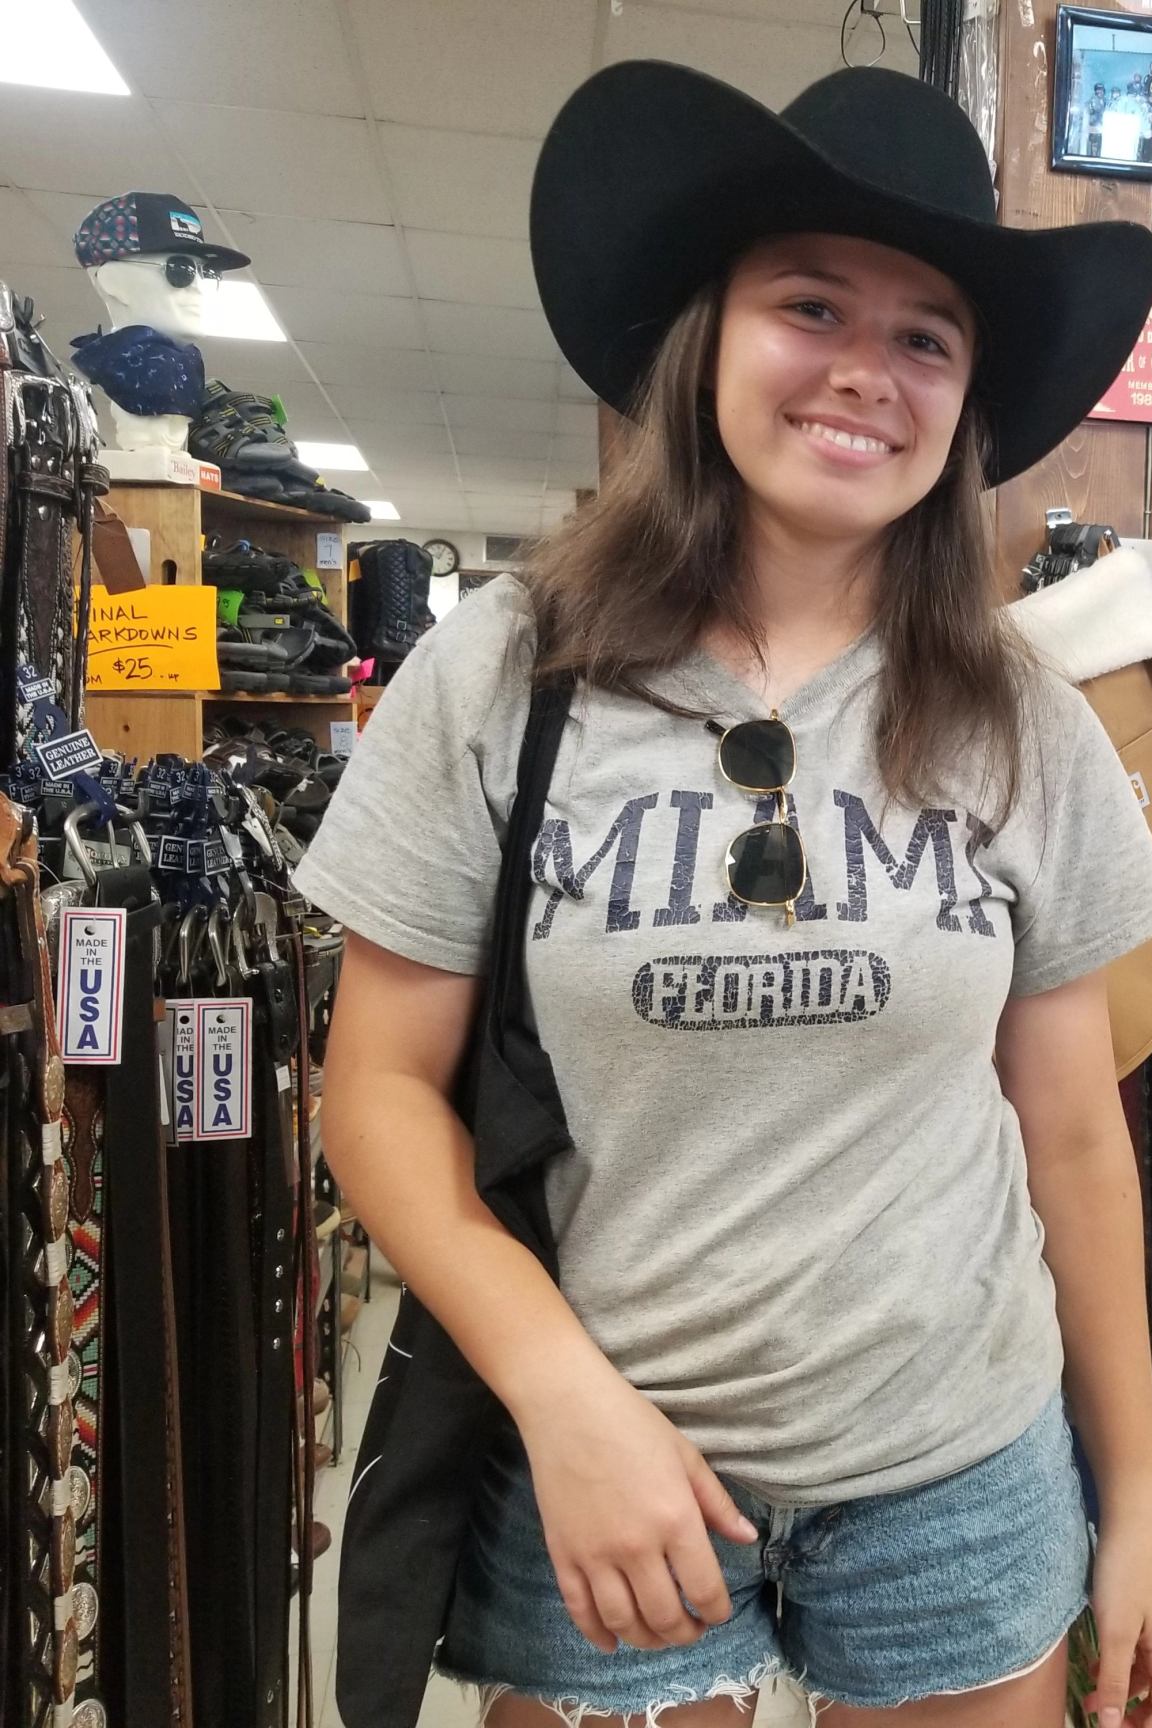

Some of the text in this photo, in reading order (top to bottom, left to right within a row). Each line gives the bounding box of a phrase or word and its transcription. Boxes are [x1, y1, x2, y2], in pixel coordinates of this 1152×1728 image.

[75, 604, 148, 622] INAL
[86, 626, 198, 643] ARKDOWNS
[23, 665, 37, 679] 32
[45, 736, 91, 761] GENUINE
[50, 748, 96, 773] LEATHER
[76, 939, 108, 947] MADE
[81, 957, 102, 966] THE
[651, 956, 878, 1017] FLORIDA
[76, 969, 103, 1050] USA
[208, 1026, 236, 1034] MADE
[177, 1044, 194, 1052] THE
[212, 1054, 233, 1127] USA
